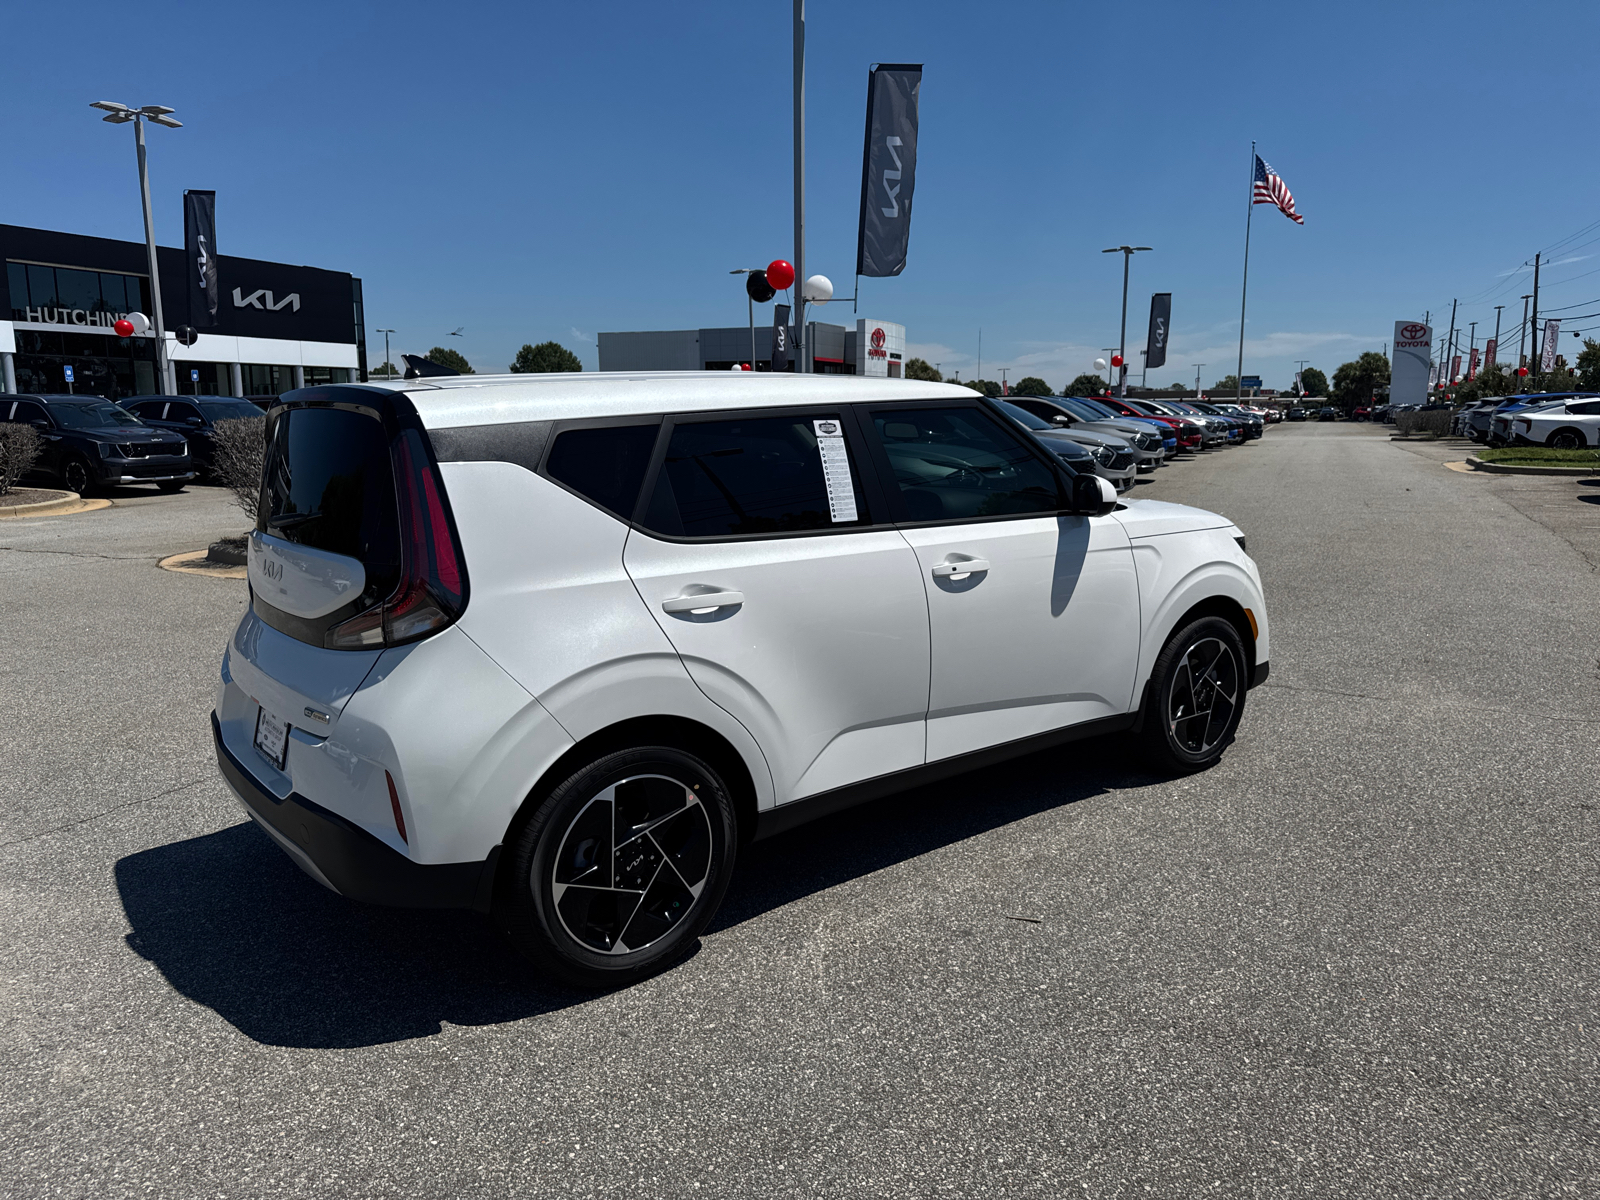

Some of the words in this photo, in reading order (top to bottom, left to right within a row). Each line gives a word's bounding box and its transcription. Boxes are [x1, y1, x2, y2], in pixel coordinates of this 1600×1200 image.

[881, 136, 903, 217] KIA
[232, 287, 300, 312] KIA
[1396, 340, 1430, 348] TOYOTA
